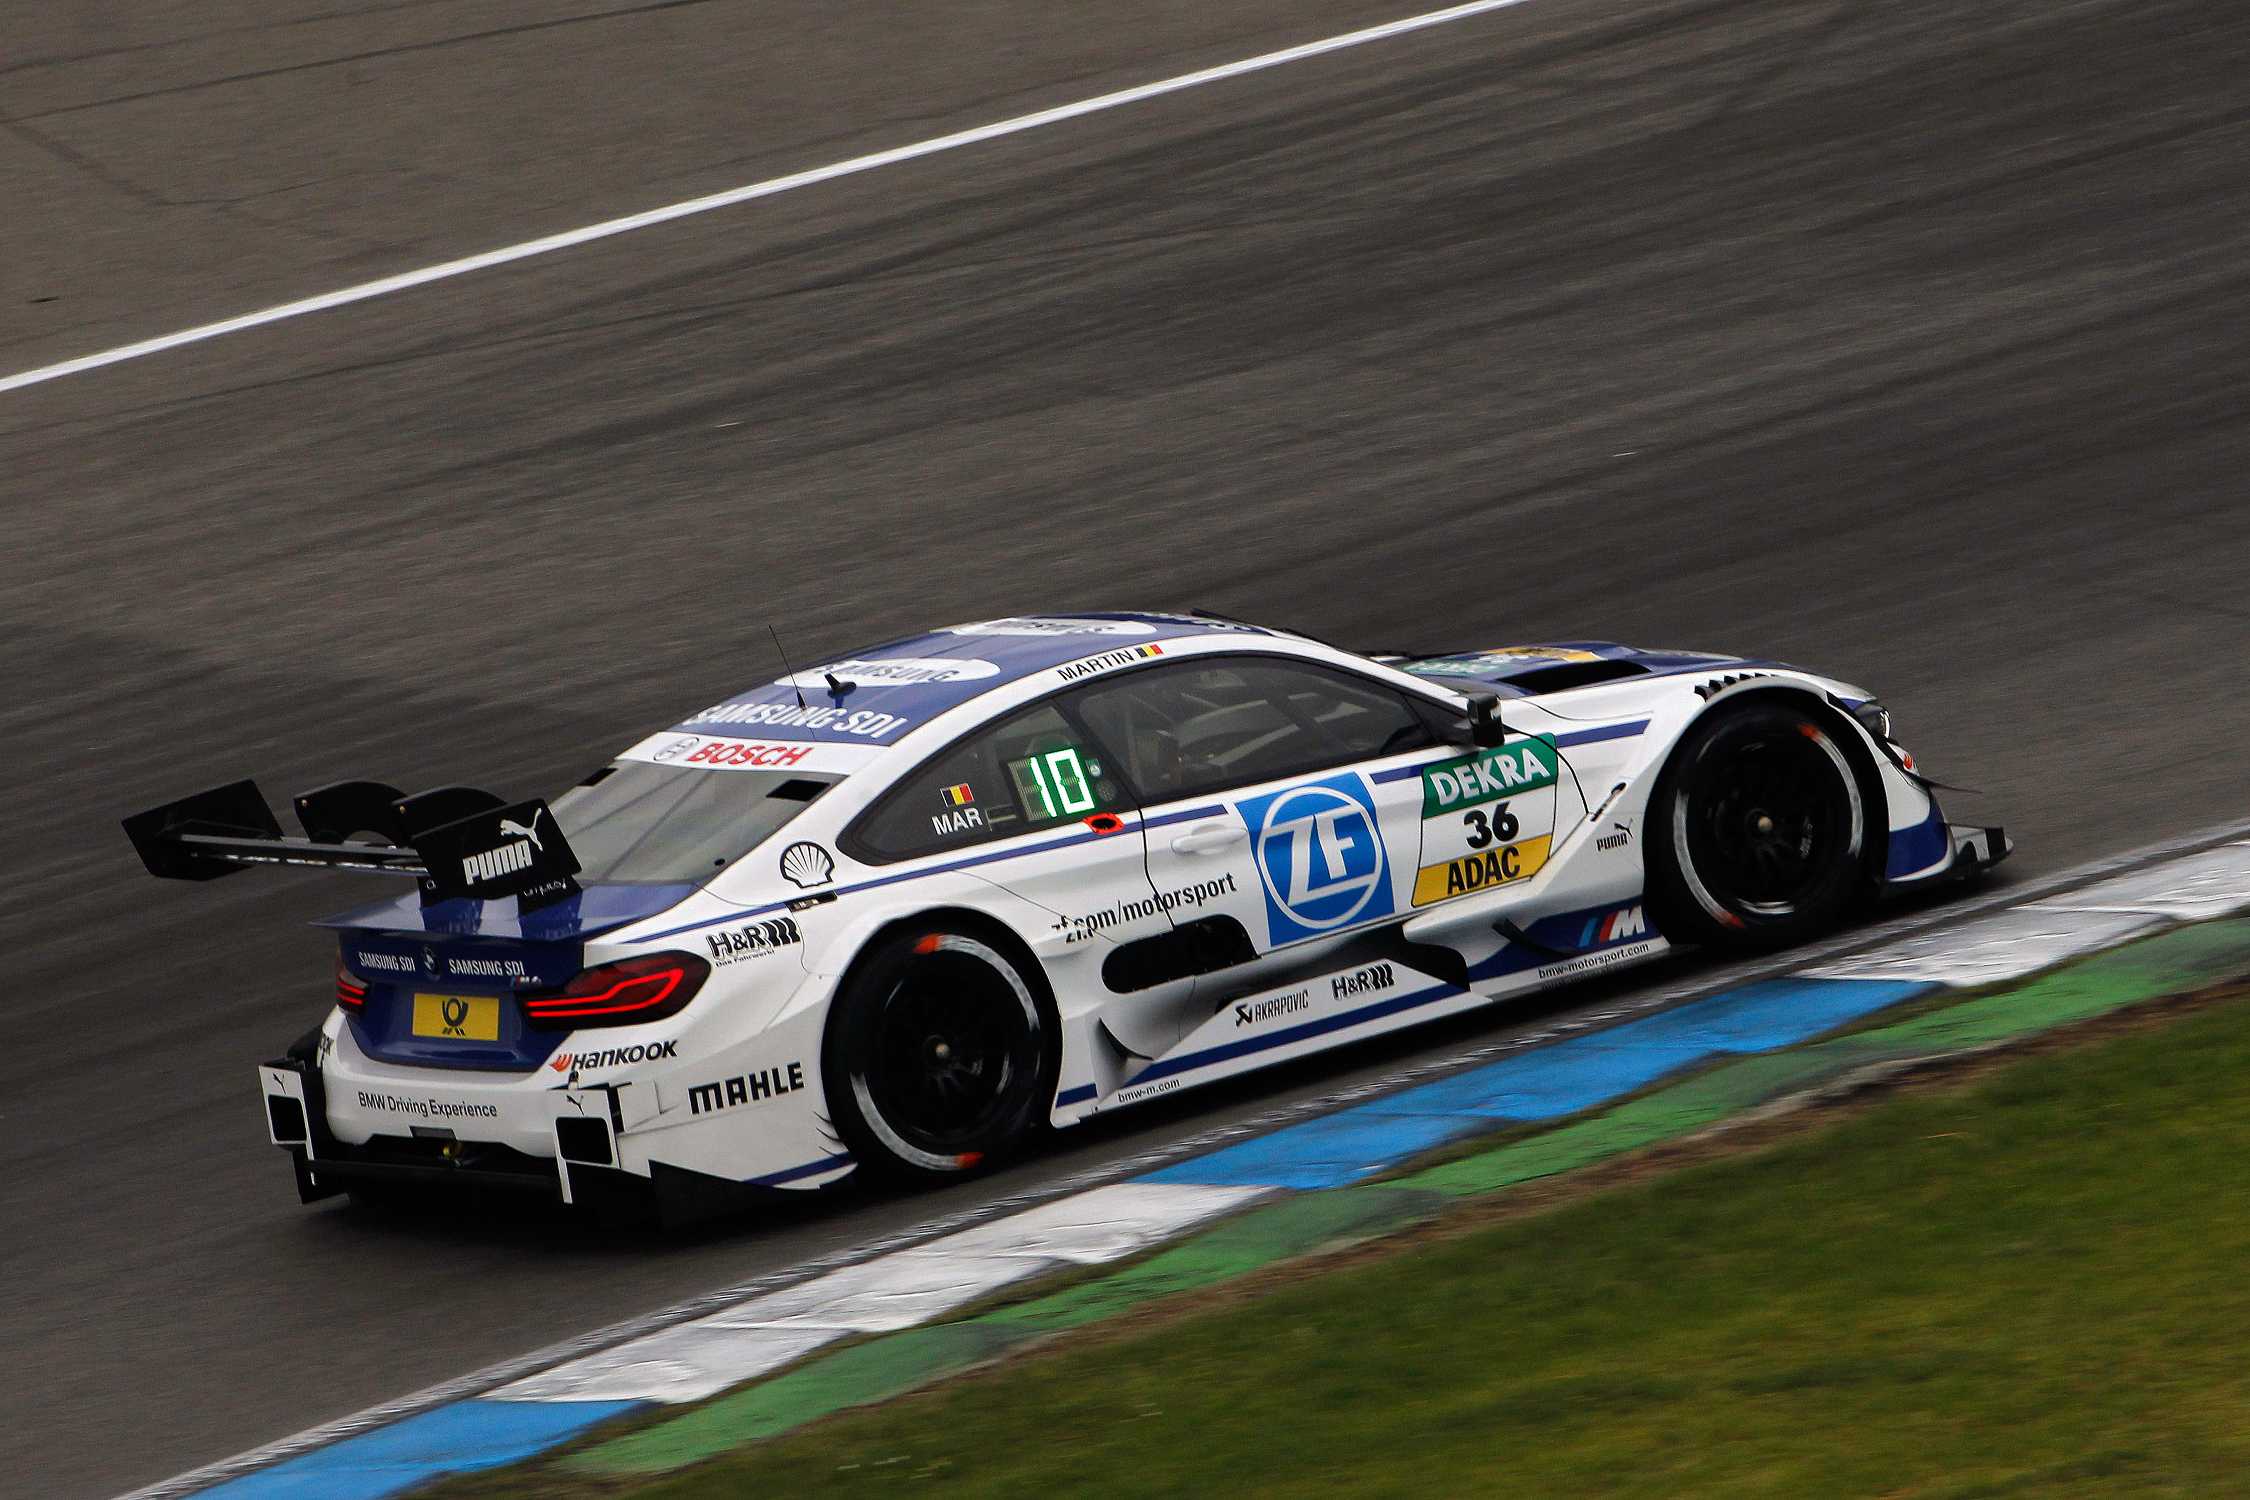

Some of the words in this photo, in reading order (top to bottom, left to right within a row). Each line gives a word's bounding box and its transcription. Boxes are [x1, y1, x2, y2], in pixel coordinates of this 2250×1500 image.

[1056, 650, 1135, 681] MARTIN
[682, 703, 846, 729] SAMSUNG
[832, 710, 907, 739] SDI
[687, 742, 814, 767] BOSCH
[1030, 748, 1095, 818] 10
[1429, 748, 1551, 806] DEKRA
[931, 808, 983, 835] MAR
[1463, 800, 1520, 849] 36
[1263, 805, 1377, 907] ZF
[1596, 832, 1629, 852] PUMA
[463, 839, 533, 885] PUMA
[1447, 846, 1521, 895] ADAC
[706, 924, 776, 958] H&R
[358, 951, 399, 971] SAMSUNG
[399, 957, 416, 971] SDI
[449, 959, 502, 976] SAMSUNG
[504, 960, 525, 976] SDI
[1538, 943, 1649, 979] bmw-motorsport.com
[1331, 969, 1373, 1000] H&R
[358, 1091, 386, 1110] BMW
[388, 1097, 428, 1117] Driving
[429, 1100, 498, 1117] Experience
[688, 1061, 805, 1116] MAHLE
[1118, 1079, 1181, 1103] bmw-m.com
